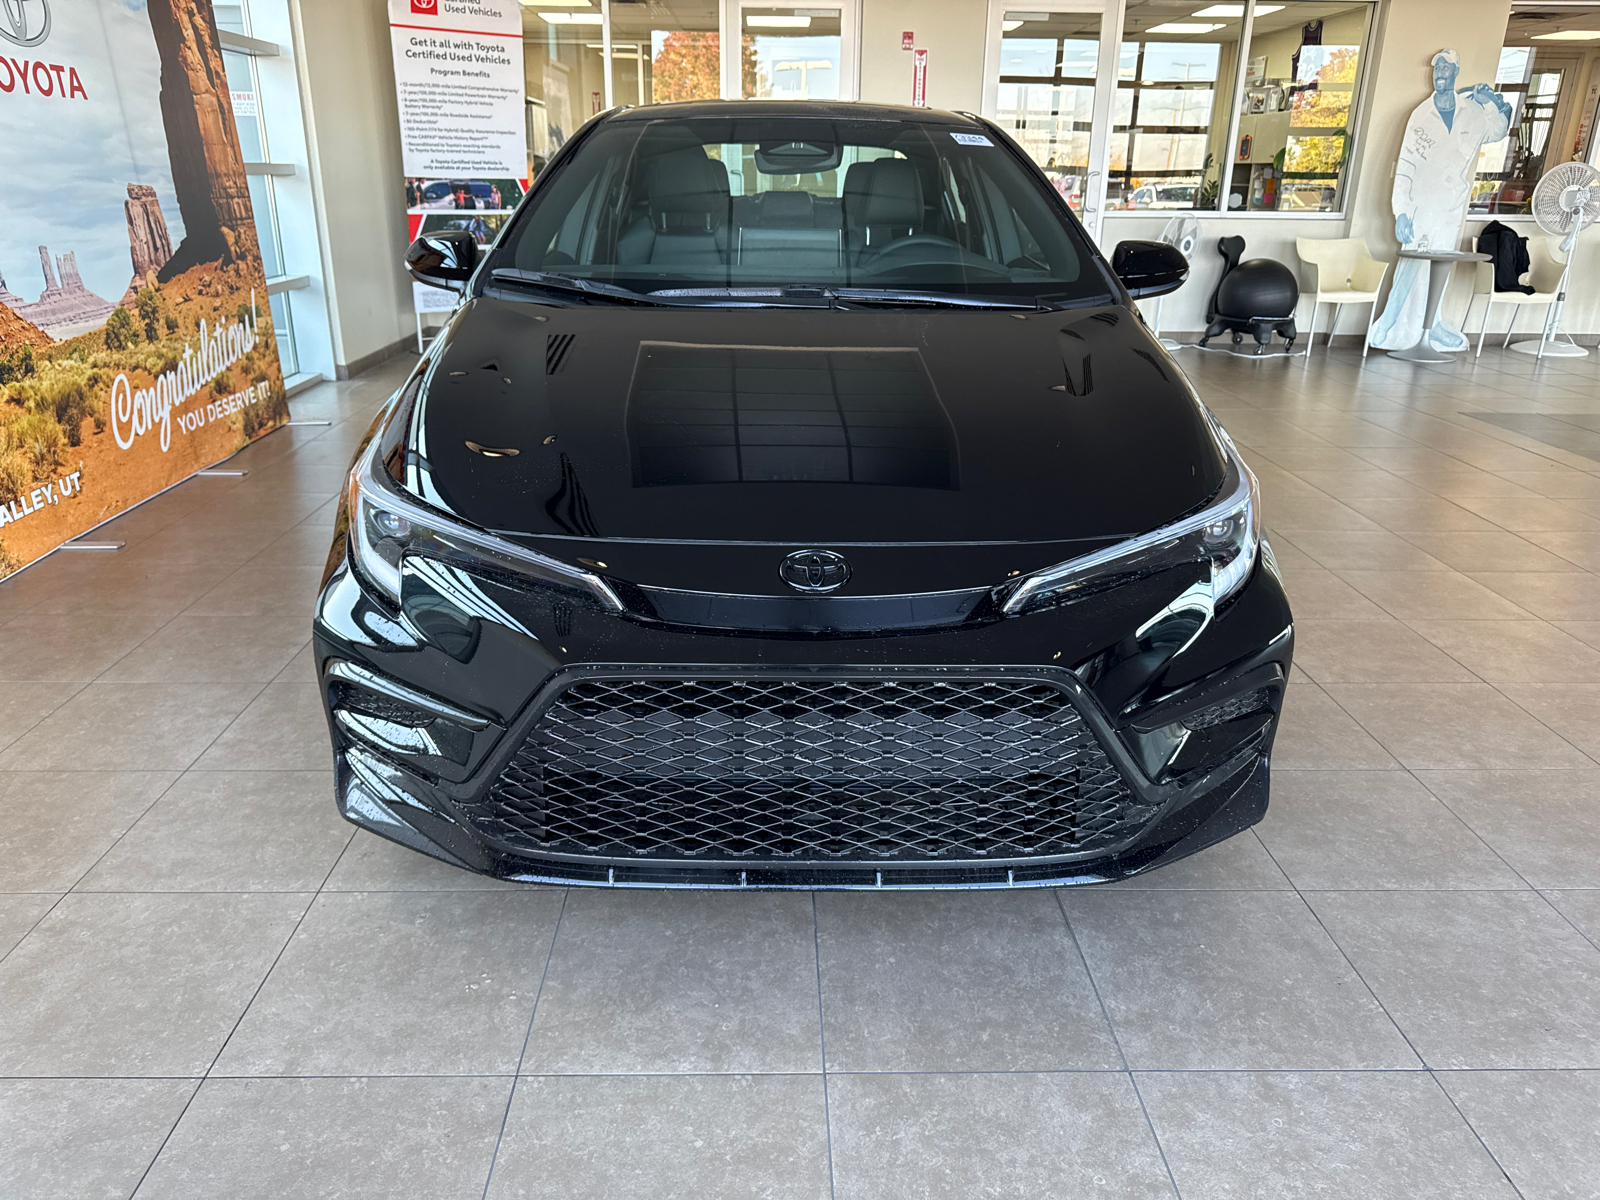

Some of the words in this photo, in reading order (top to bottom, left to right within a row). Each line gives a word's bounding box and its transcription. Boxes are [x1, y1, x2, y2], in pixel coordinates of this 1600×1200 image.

[444, 4, 466, 14] Used
[468, 6, 502, 18] Vehicles
[405, 49, 447, 60] Certified
[449, 52, 472, 62] Used
[474, 54, 511, 65] Vehicles
[410, 37, 428, 46] Get
[430, 38, 437, 48] it
[438, 40, 451, 49] all
[453, 41, 474, 50] with
[475, 42, 505, 54] Toyota
[0, 56, 88, 100] OYOTA
[430, 68, 460, 77] Program
[462, 70, 490, 78] Benefits
[111, 288, 260, 452] Congratulations!
[177, 408, 205, 434] YOU
[206, 386, 257, 422] DESERVE
[257, 380, 271, 400] IT!
[0, 483, 58, 528] ALLEY,
[58, 471, 80, 496] UT
